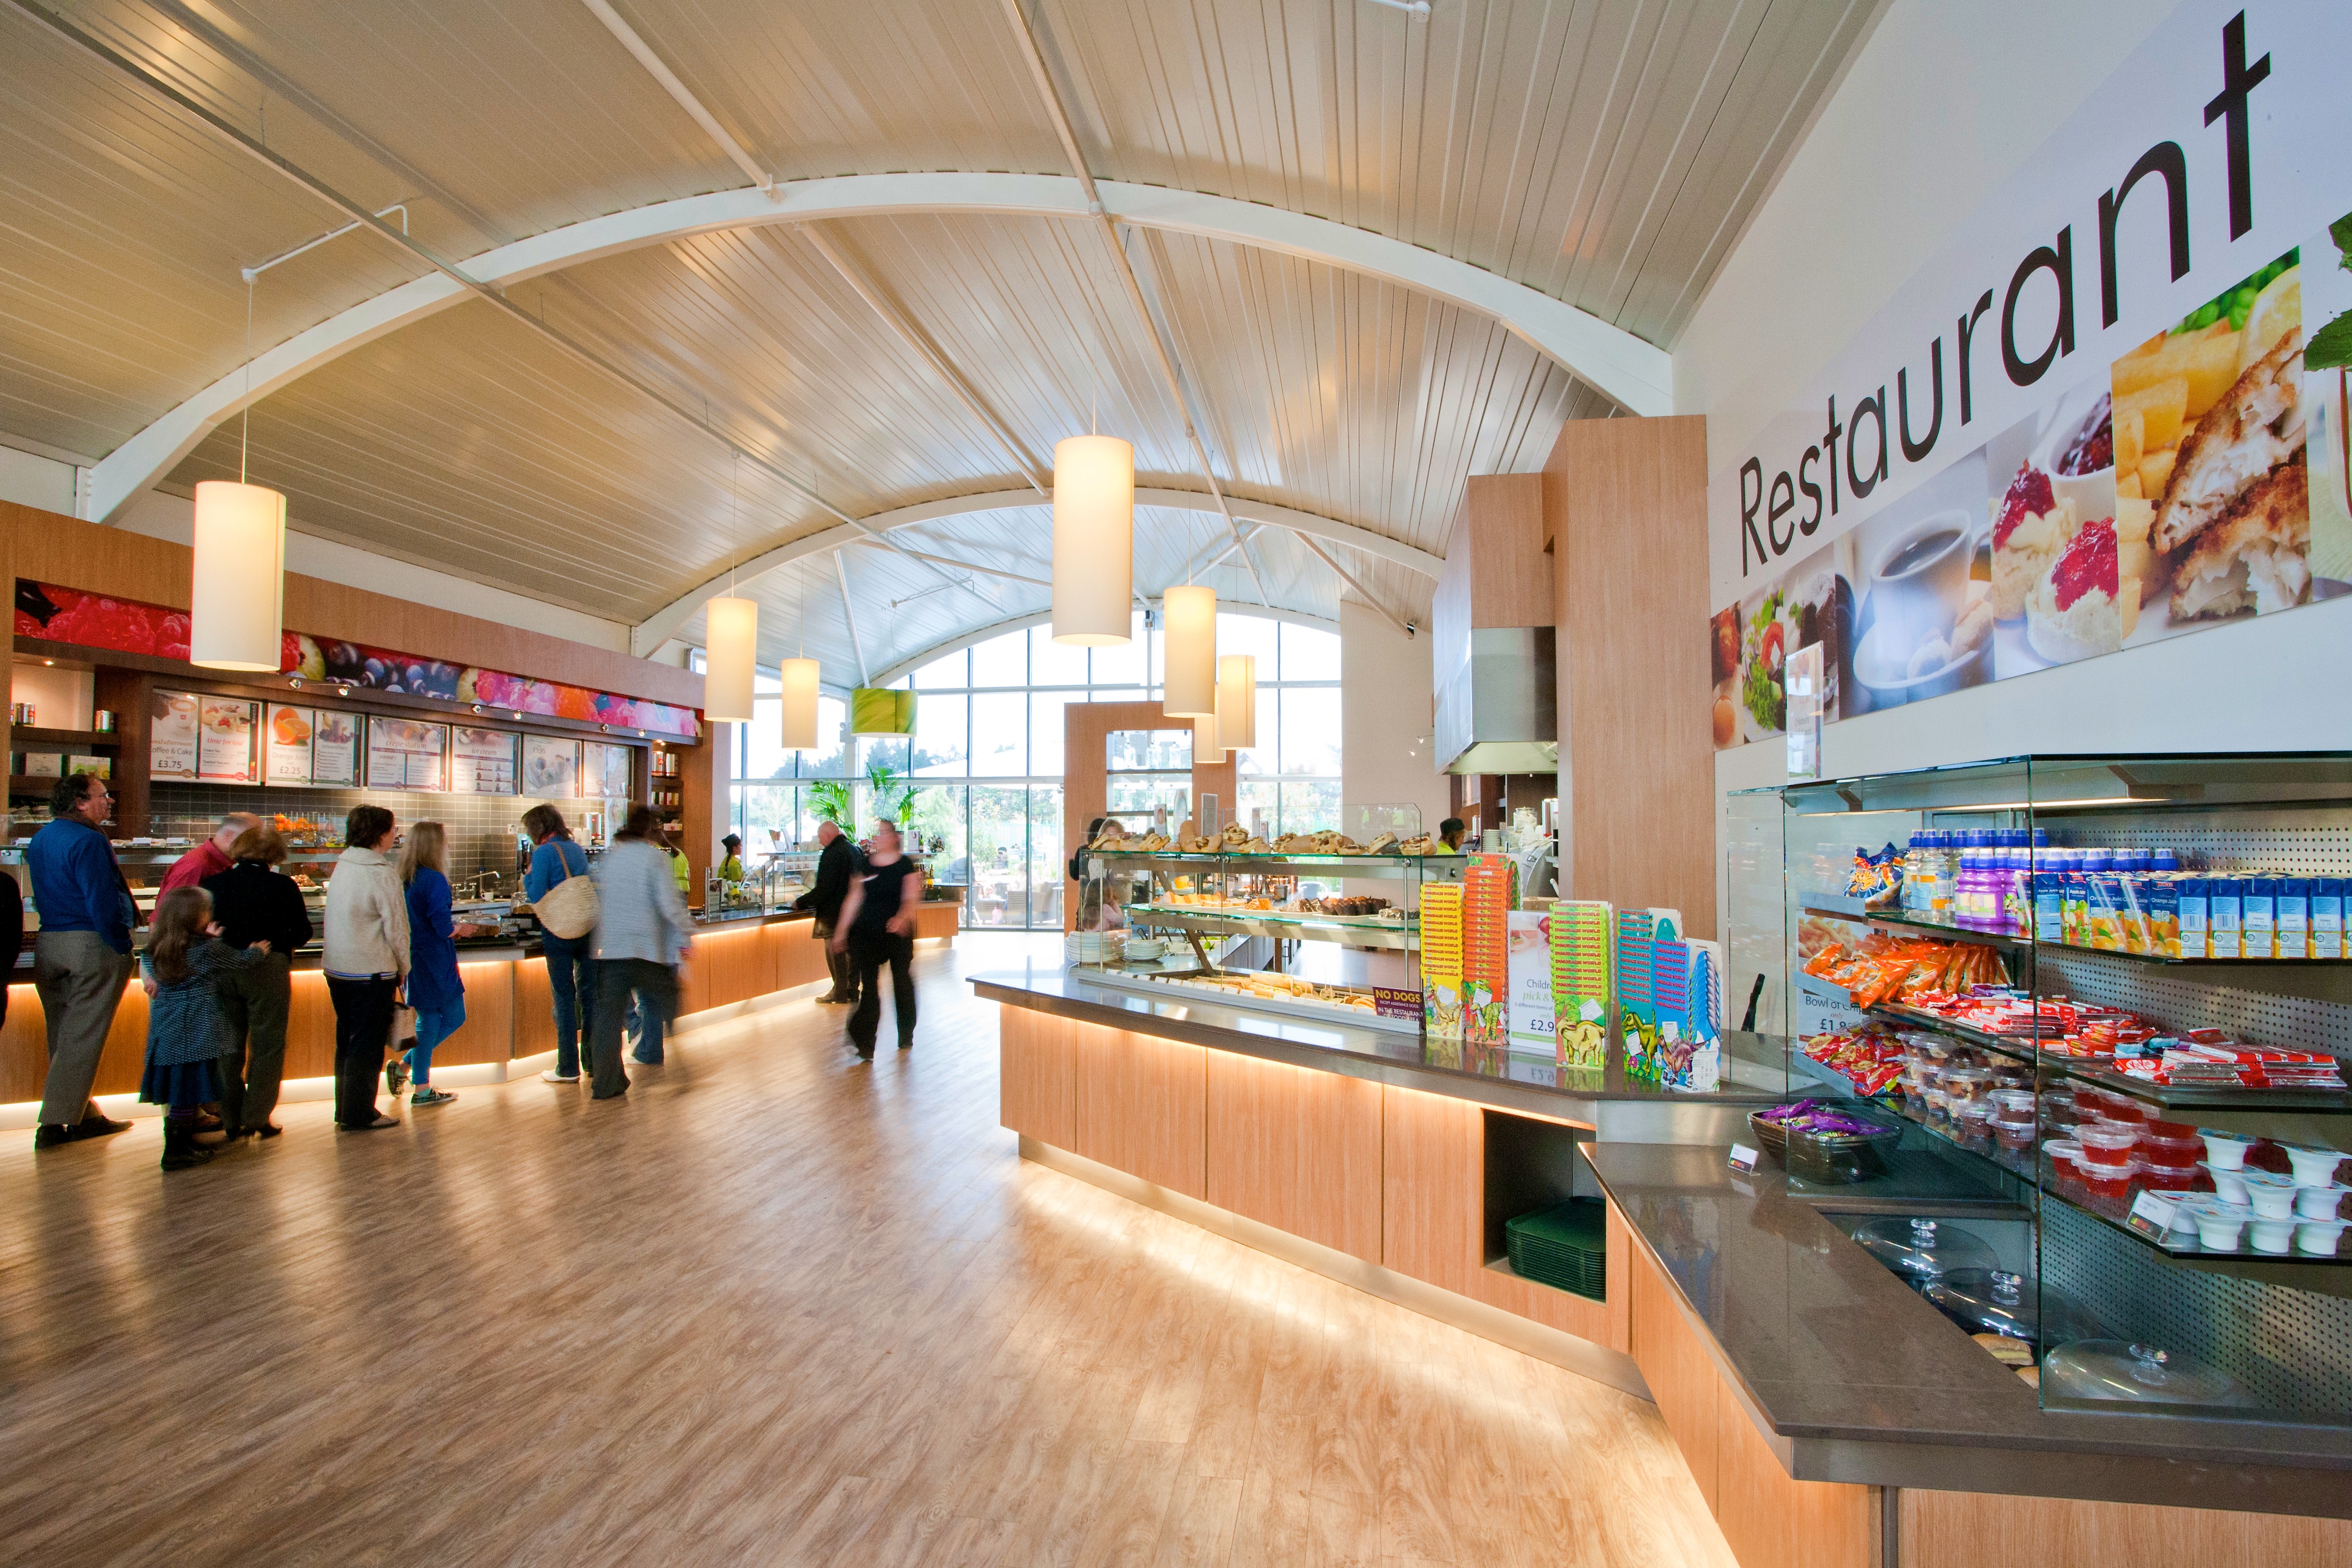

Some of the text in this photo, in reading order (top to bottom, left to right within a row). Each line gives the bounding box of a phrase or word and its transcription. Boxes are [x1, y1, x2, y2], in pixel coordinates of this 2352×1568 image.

[1740, 8, 2270, 578] Restaurant
[404, 741, 427, 749] station
[158, 760, 182, 768] £3.75
[280, 766, 301, 775] £2.25
[1527, 979, 1551, 989] Childr
[1375, 990, 1420, 1003] NO DOGS
[1523, 991, 1550, 1002] pick &
[1805, 996, 1828, 1008] Bowl
[1530, 1019, 1554, 1032] £2.9
